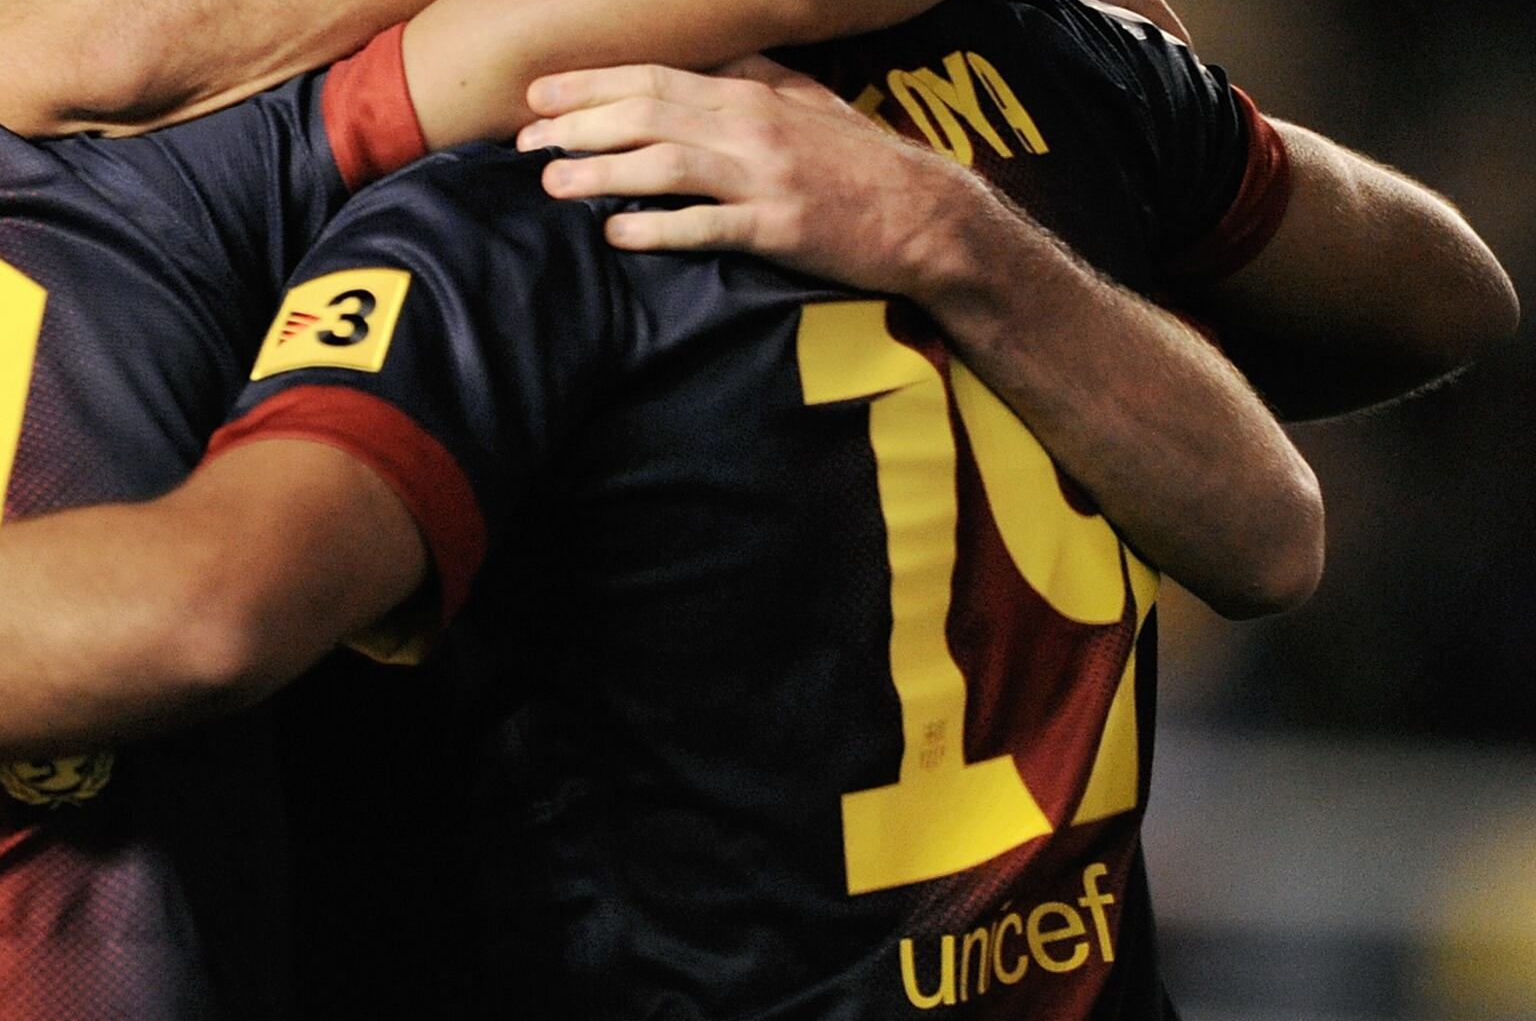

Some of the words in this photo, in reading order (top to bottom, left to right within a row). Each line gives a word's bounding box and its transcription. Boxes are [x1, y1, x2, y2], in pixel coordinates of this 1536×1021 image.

[317, 289, 376, 347] 3
[797, 299, 1161, 895] 19
[899, 862, 1115, 1009] unicef
